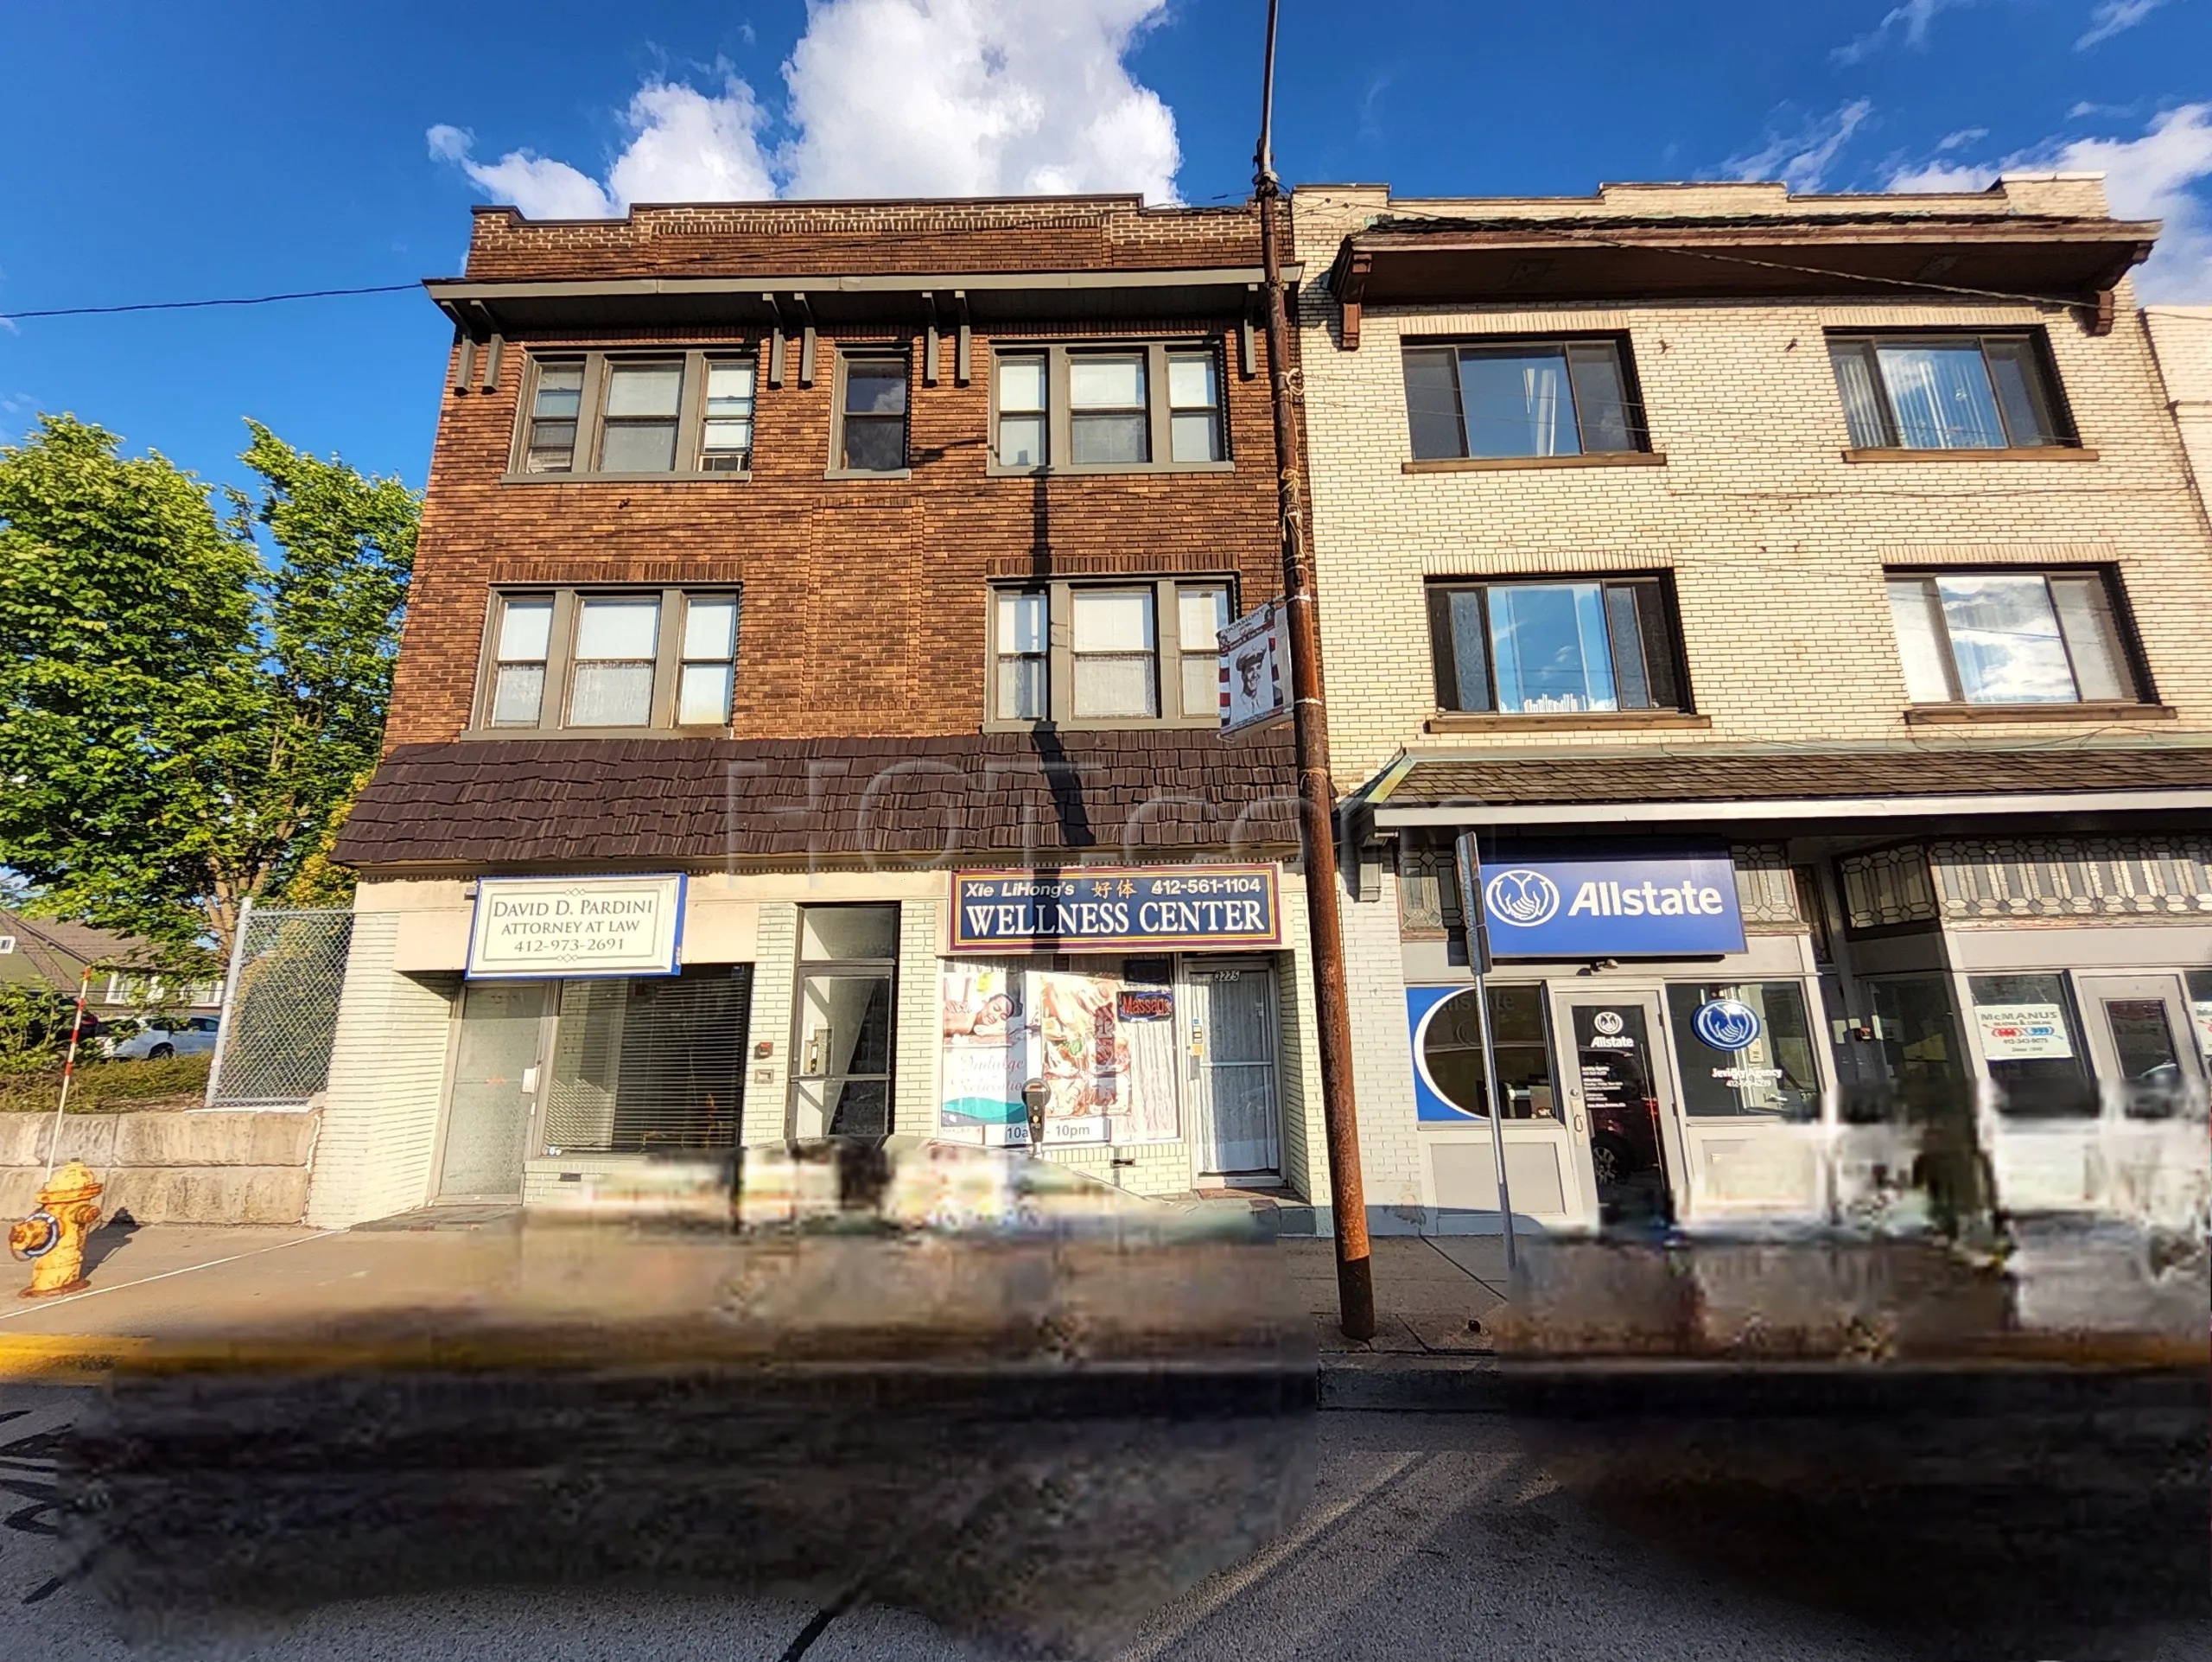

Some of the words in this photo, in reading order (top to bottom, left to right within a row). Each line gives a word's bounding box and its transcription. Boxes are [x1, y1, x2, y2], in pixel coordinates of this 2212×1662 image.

[965, 882, 994, 897] Xie
[1001, 882, 1074, 898] LiHong's
[1151, 878, 1262, 895] 412-561-1104
[1568, 880, 1724, 916] Allstate
[493, 901, 549, 918] DAVID
[555, 900, 574, 915] D.
[580, 899, 653, 915] PARDINI
[966, 901, 1130, 936] WELLNESS
[1139, 900, 1266, 933] CENTER
[501, 921, 582, 935] ATTORNEY
[584, 921, 605, 933] AT
[608, 920, 640, 933] LAW
[514, 938, 625, 952] 412-973-2691
[1215, 971, 1240, 981] 3225
[1981, 1011, 2057, 1021] McMANUS
[1591, 1036, 1635, 1048] Allstate
[1007, 1127, 1029, 1139] 10a
[1056, 1125, 1090, 1137] 10pm
